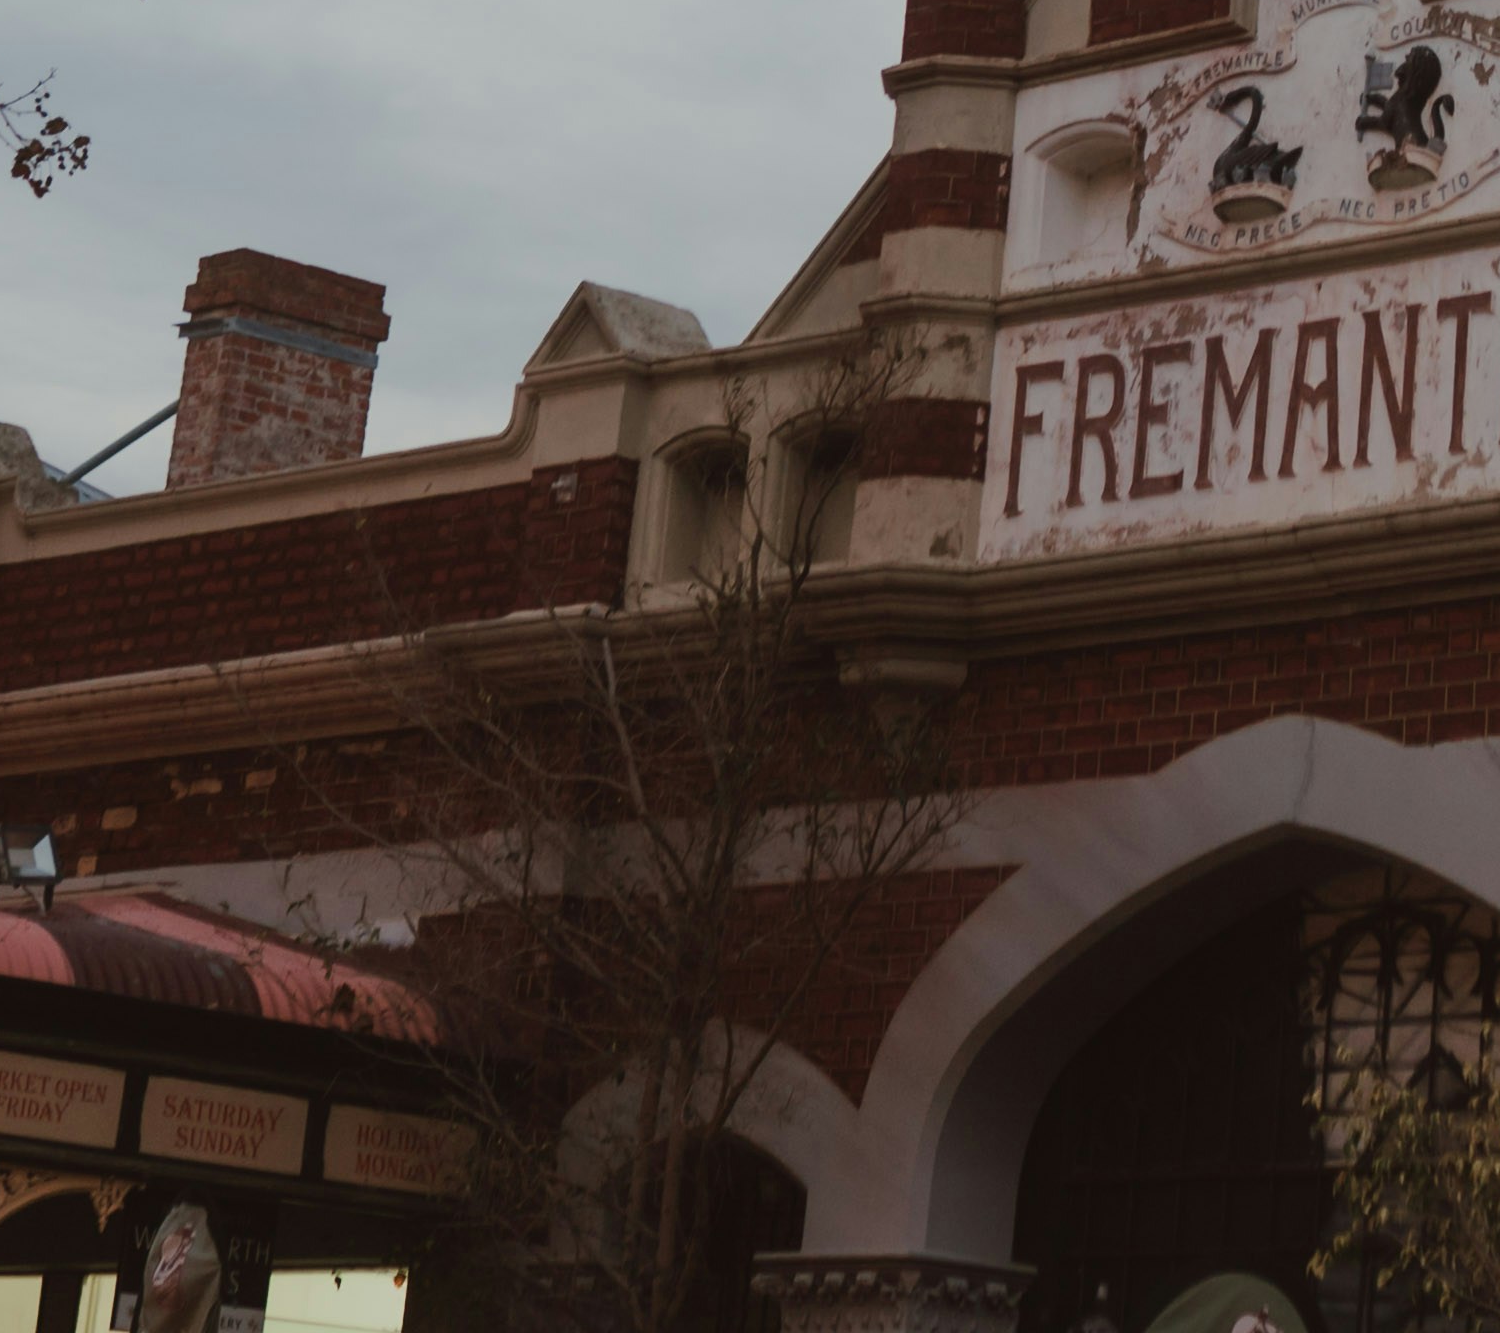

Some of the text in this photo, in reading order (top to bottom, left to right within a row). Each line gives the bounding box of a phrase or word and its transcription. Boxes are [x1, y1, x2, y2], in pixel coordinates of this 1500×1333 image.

[1193, 50, 1285, 89] FREMANTLE
[1393, 171, 1471, 219] PRETIO
[54, 1075, 109, 1105] OPEN
[162, 1095, 285, 1133] SATURDAY
[174, 1126, 266, 1162] SUNDAY
[355, 1152, 444, 1183] MONDAY
[227, 1236, 273, 1264] RTH
